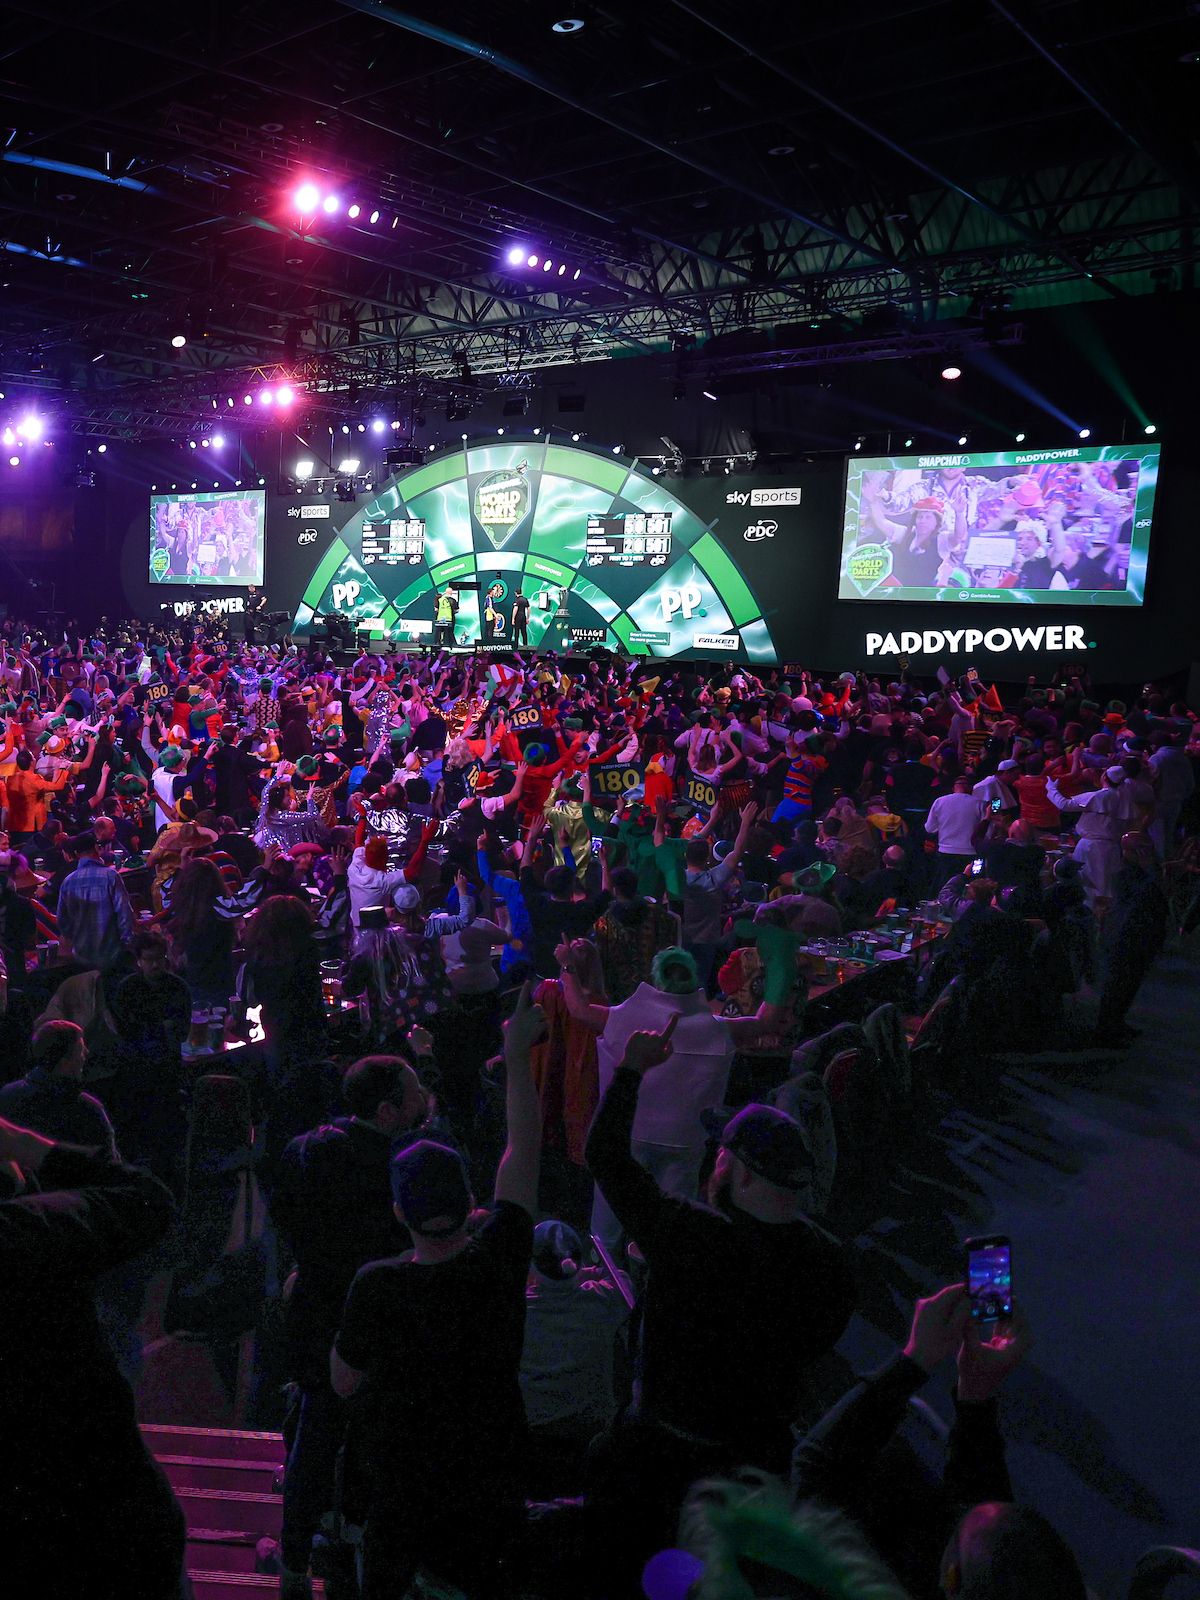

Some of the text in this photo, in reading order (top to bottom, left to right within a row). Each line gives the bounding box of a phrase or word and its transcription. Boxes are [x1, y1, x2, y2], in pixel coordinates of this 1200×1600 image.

[918, 456, 961, 467] SNAPCHAT
[480, 490, 521, 506] WORLD
[726, 491, 798, 506] sky sports
[287, 507, 328, 518] sky sports
[481, 504, 516, 517] DARTS
[572, 629, 604, 638] VILLAGE
[147, 684, 169, 700] 180
[511, 708, 540, 726] 180
[594, 768, 640, 793] 180
[688, 780, 716, 806] 180
